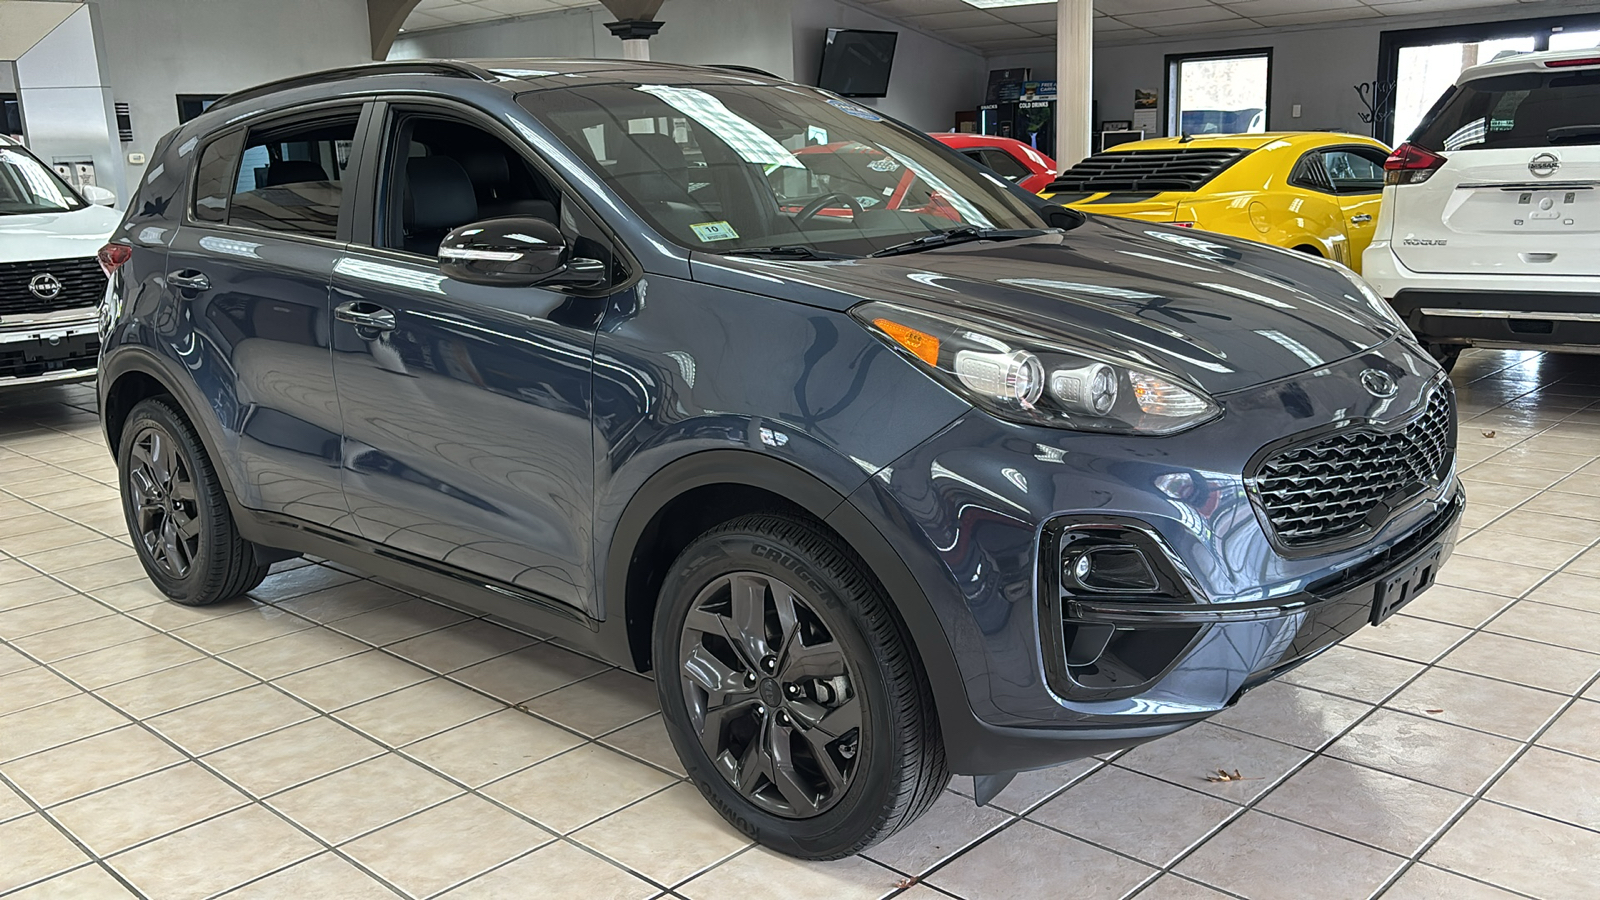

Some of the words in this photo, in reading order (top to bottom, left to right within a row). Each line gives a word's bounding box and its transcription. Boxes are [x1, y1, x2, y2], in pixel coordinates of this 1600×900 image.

[1527, 161, 1560, 170] NISSAN
[704, 225, 719, 233] 10
[1403, 238, 1448, 246] ROGUE
[28, 282, 63, 290] NISSAN
[751, 543, 837, 610] CRUGEN
[700, 780, 760, 840] KUMHO
